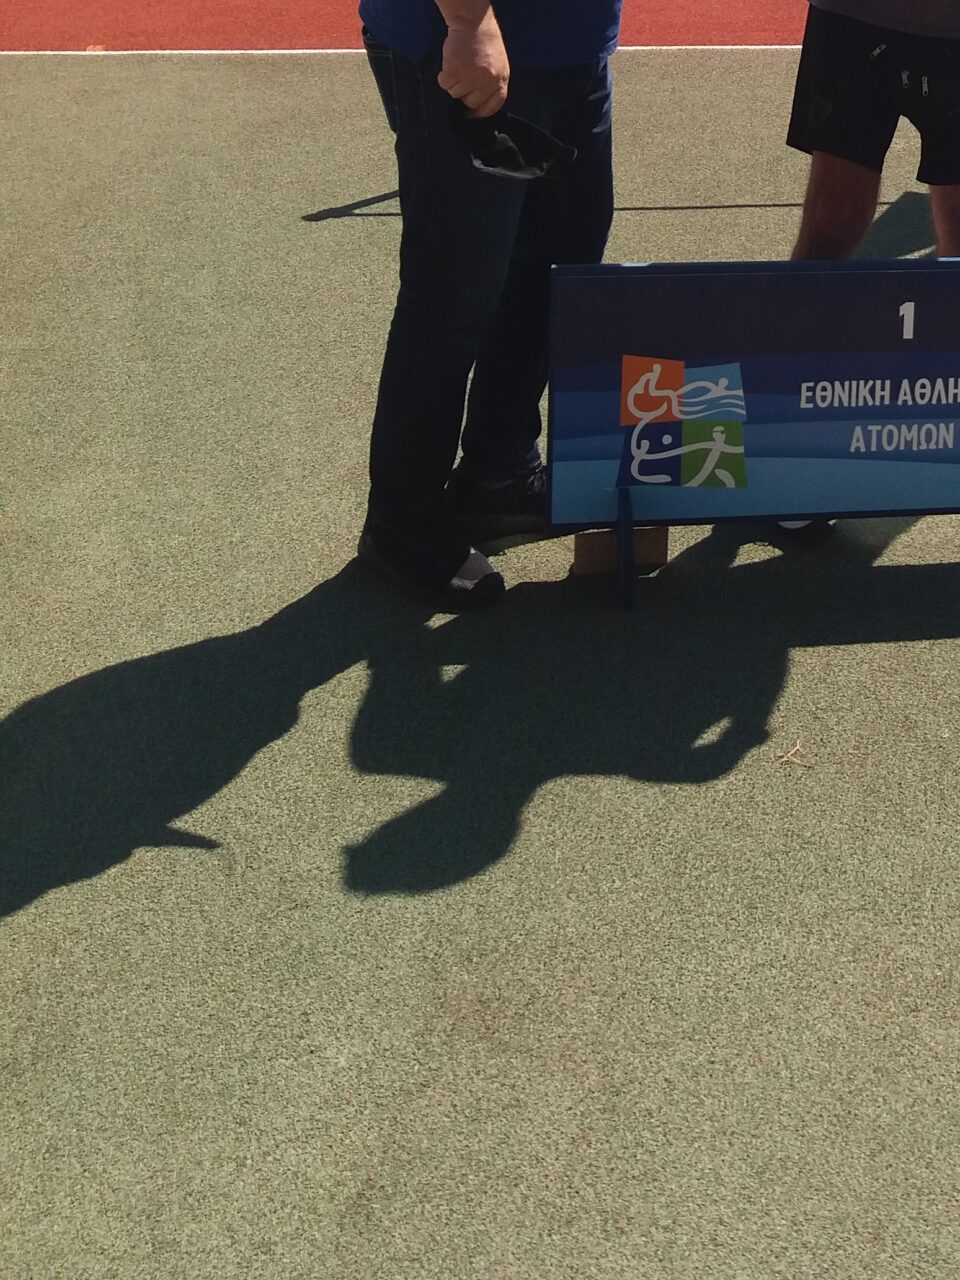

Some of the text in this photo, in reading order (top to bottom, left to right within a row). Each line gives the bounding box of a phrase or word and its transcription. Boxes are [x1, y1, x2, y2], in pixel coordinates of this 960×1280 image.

[899, 301, 915, 339] 1
[800, 379, 890, 408] ΕΘΝΙΚΗ
[850, 423, 954, 453] ΑΤΟΜΩΝ
